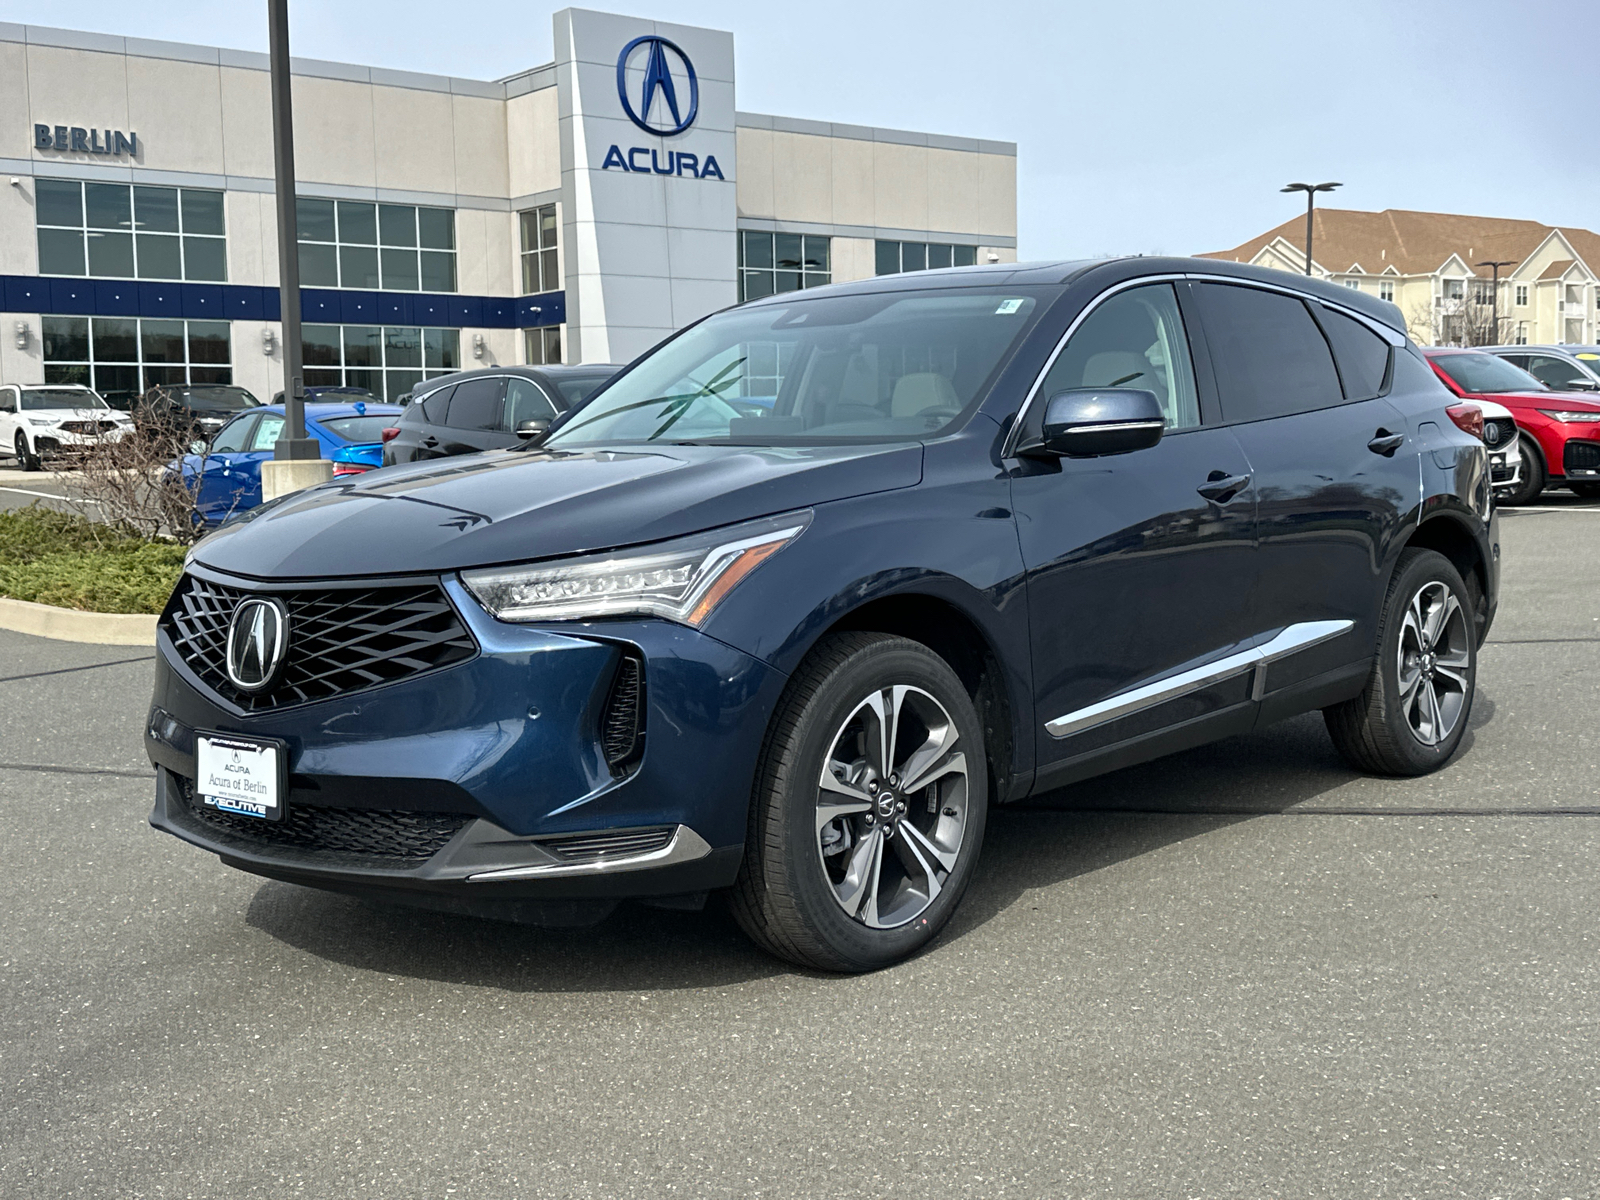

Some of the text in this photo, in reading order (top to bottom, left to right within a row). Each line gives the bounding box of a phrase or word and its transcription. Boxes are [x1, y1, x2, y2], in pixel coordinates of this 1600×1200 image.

[34, 123, 137, 156] BERLIN
[602, 144, 725, 181] ACURA
[224, 764, 251, 775] ACURA
[208, 773, 267, 794] Acura of Berlin
[204, 795, 266, 815] EXECUTIVE
